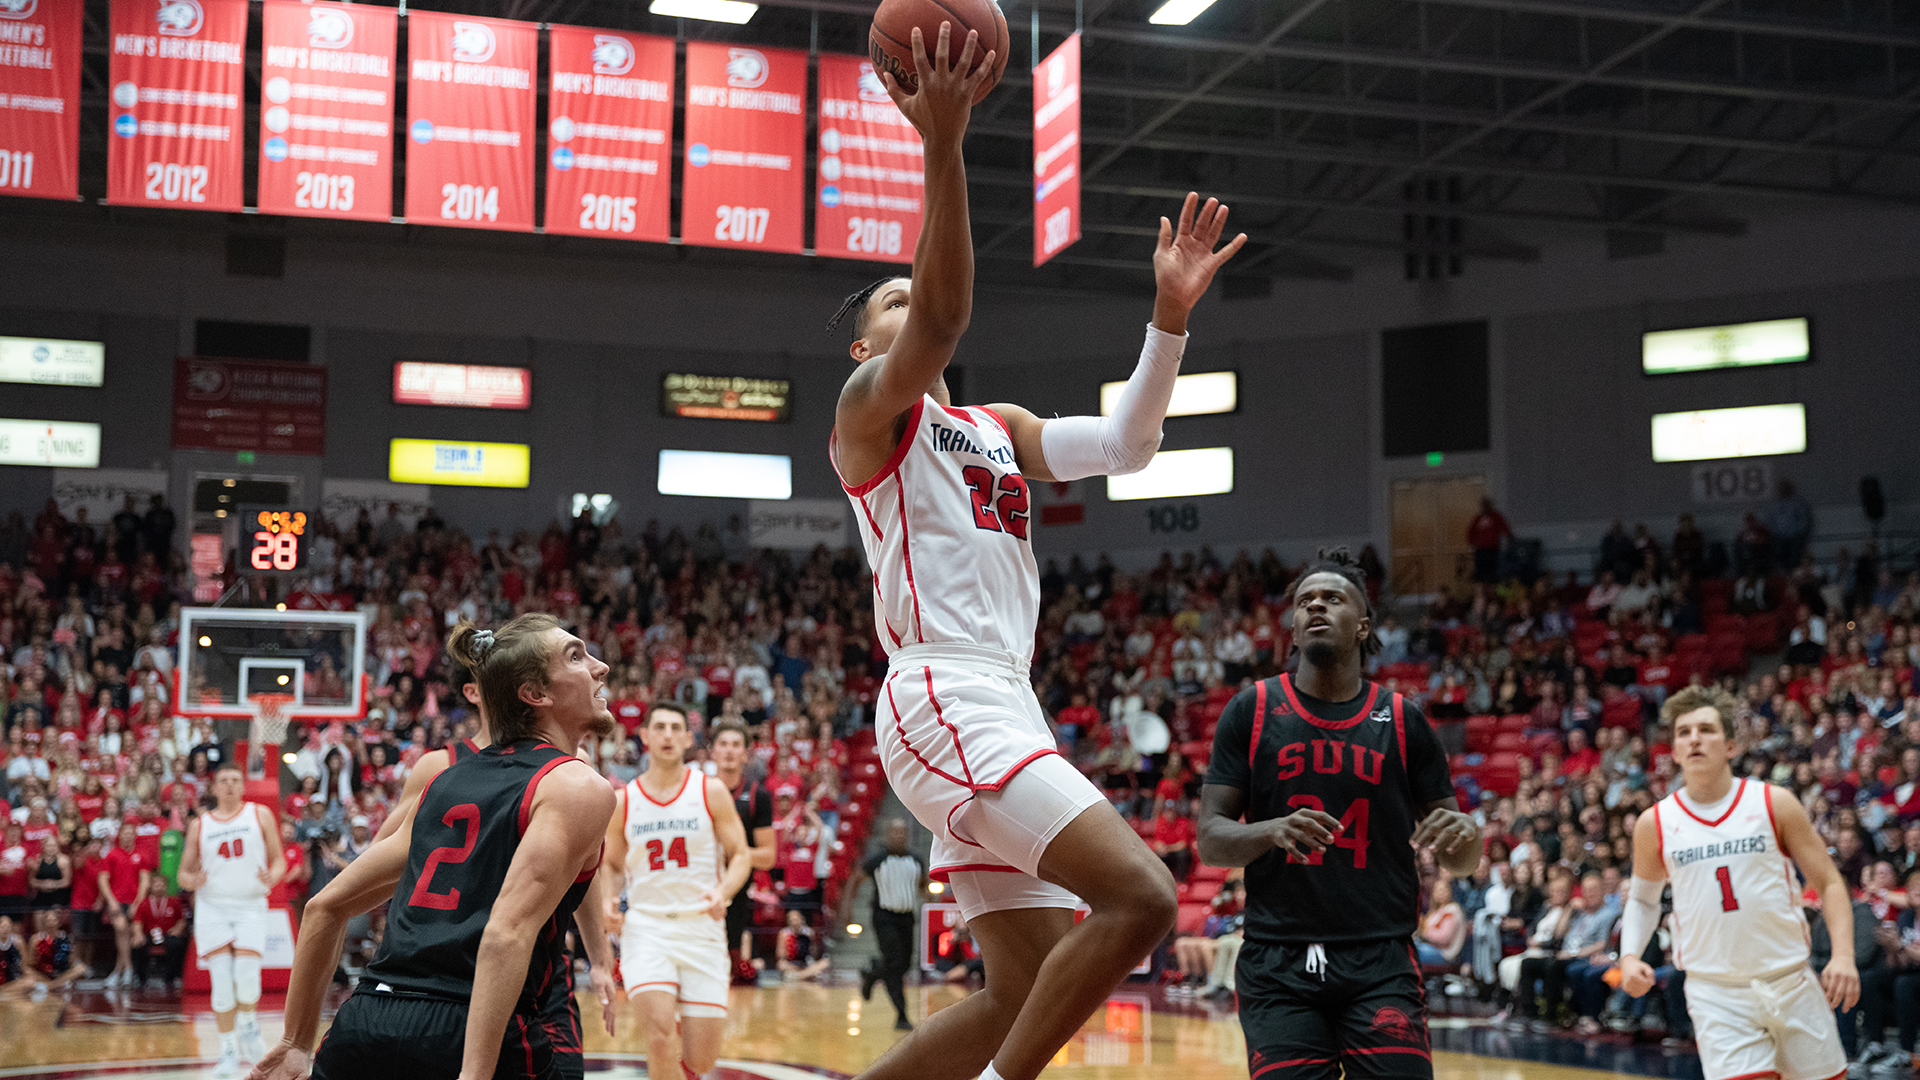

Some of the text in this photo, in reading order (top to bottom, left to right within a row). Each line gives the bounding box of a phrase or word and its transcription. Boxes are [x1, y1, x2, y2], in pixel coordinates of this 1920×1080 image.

[115, 33, 242, 64] MEN'S BASKETBALL
[267, 45, 390, 77] MEN'S BASKETBALL
[412, 59, 530, 90] MEN'S BASKETBALL
[553, 71, 669, 102] MEN'S BASKETBALL
[689, 84, 801, 115] MEN'S BASKETBALL
[821, 98, 859, 120] MEN'S
[146, 162, 208, 203] 2012
[295, 171, 355, 212] 2013
[441, 183, 500, 222] 2014
[579, 193, 637, 234] 2015
[715, 206, 769, 243] 2017
[847, 217, 902, 256] 2018
[1701, 468, 1768, 498] 108
[962, 465, 1029, 541] 22
[1148, 502, 1200, 533] 108
[251, 531, 298, 570] 28
[1278, 739, 1385, 785] SUU
[632, 818, 700, 837] TRAILBLAZERS
[408, 803, 481, 910] 2
[646, 836, 689, 871] 24
[1671, 835, 1766, 867] TRAILBLAZERS
[1715, 866, 1739, 912] 1
